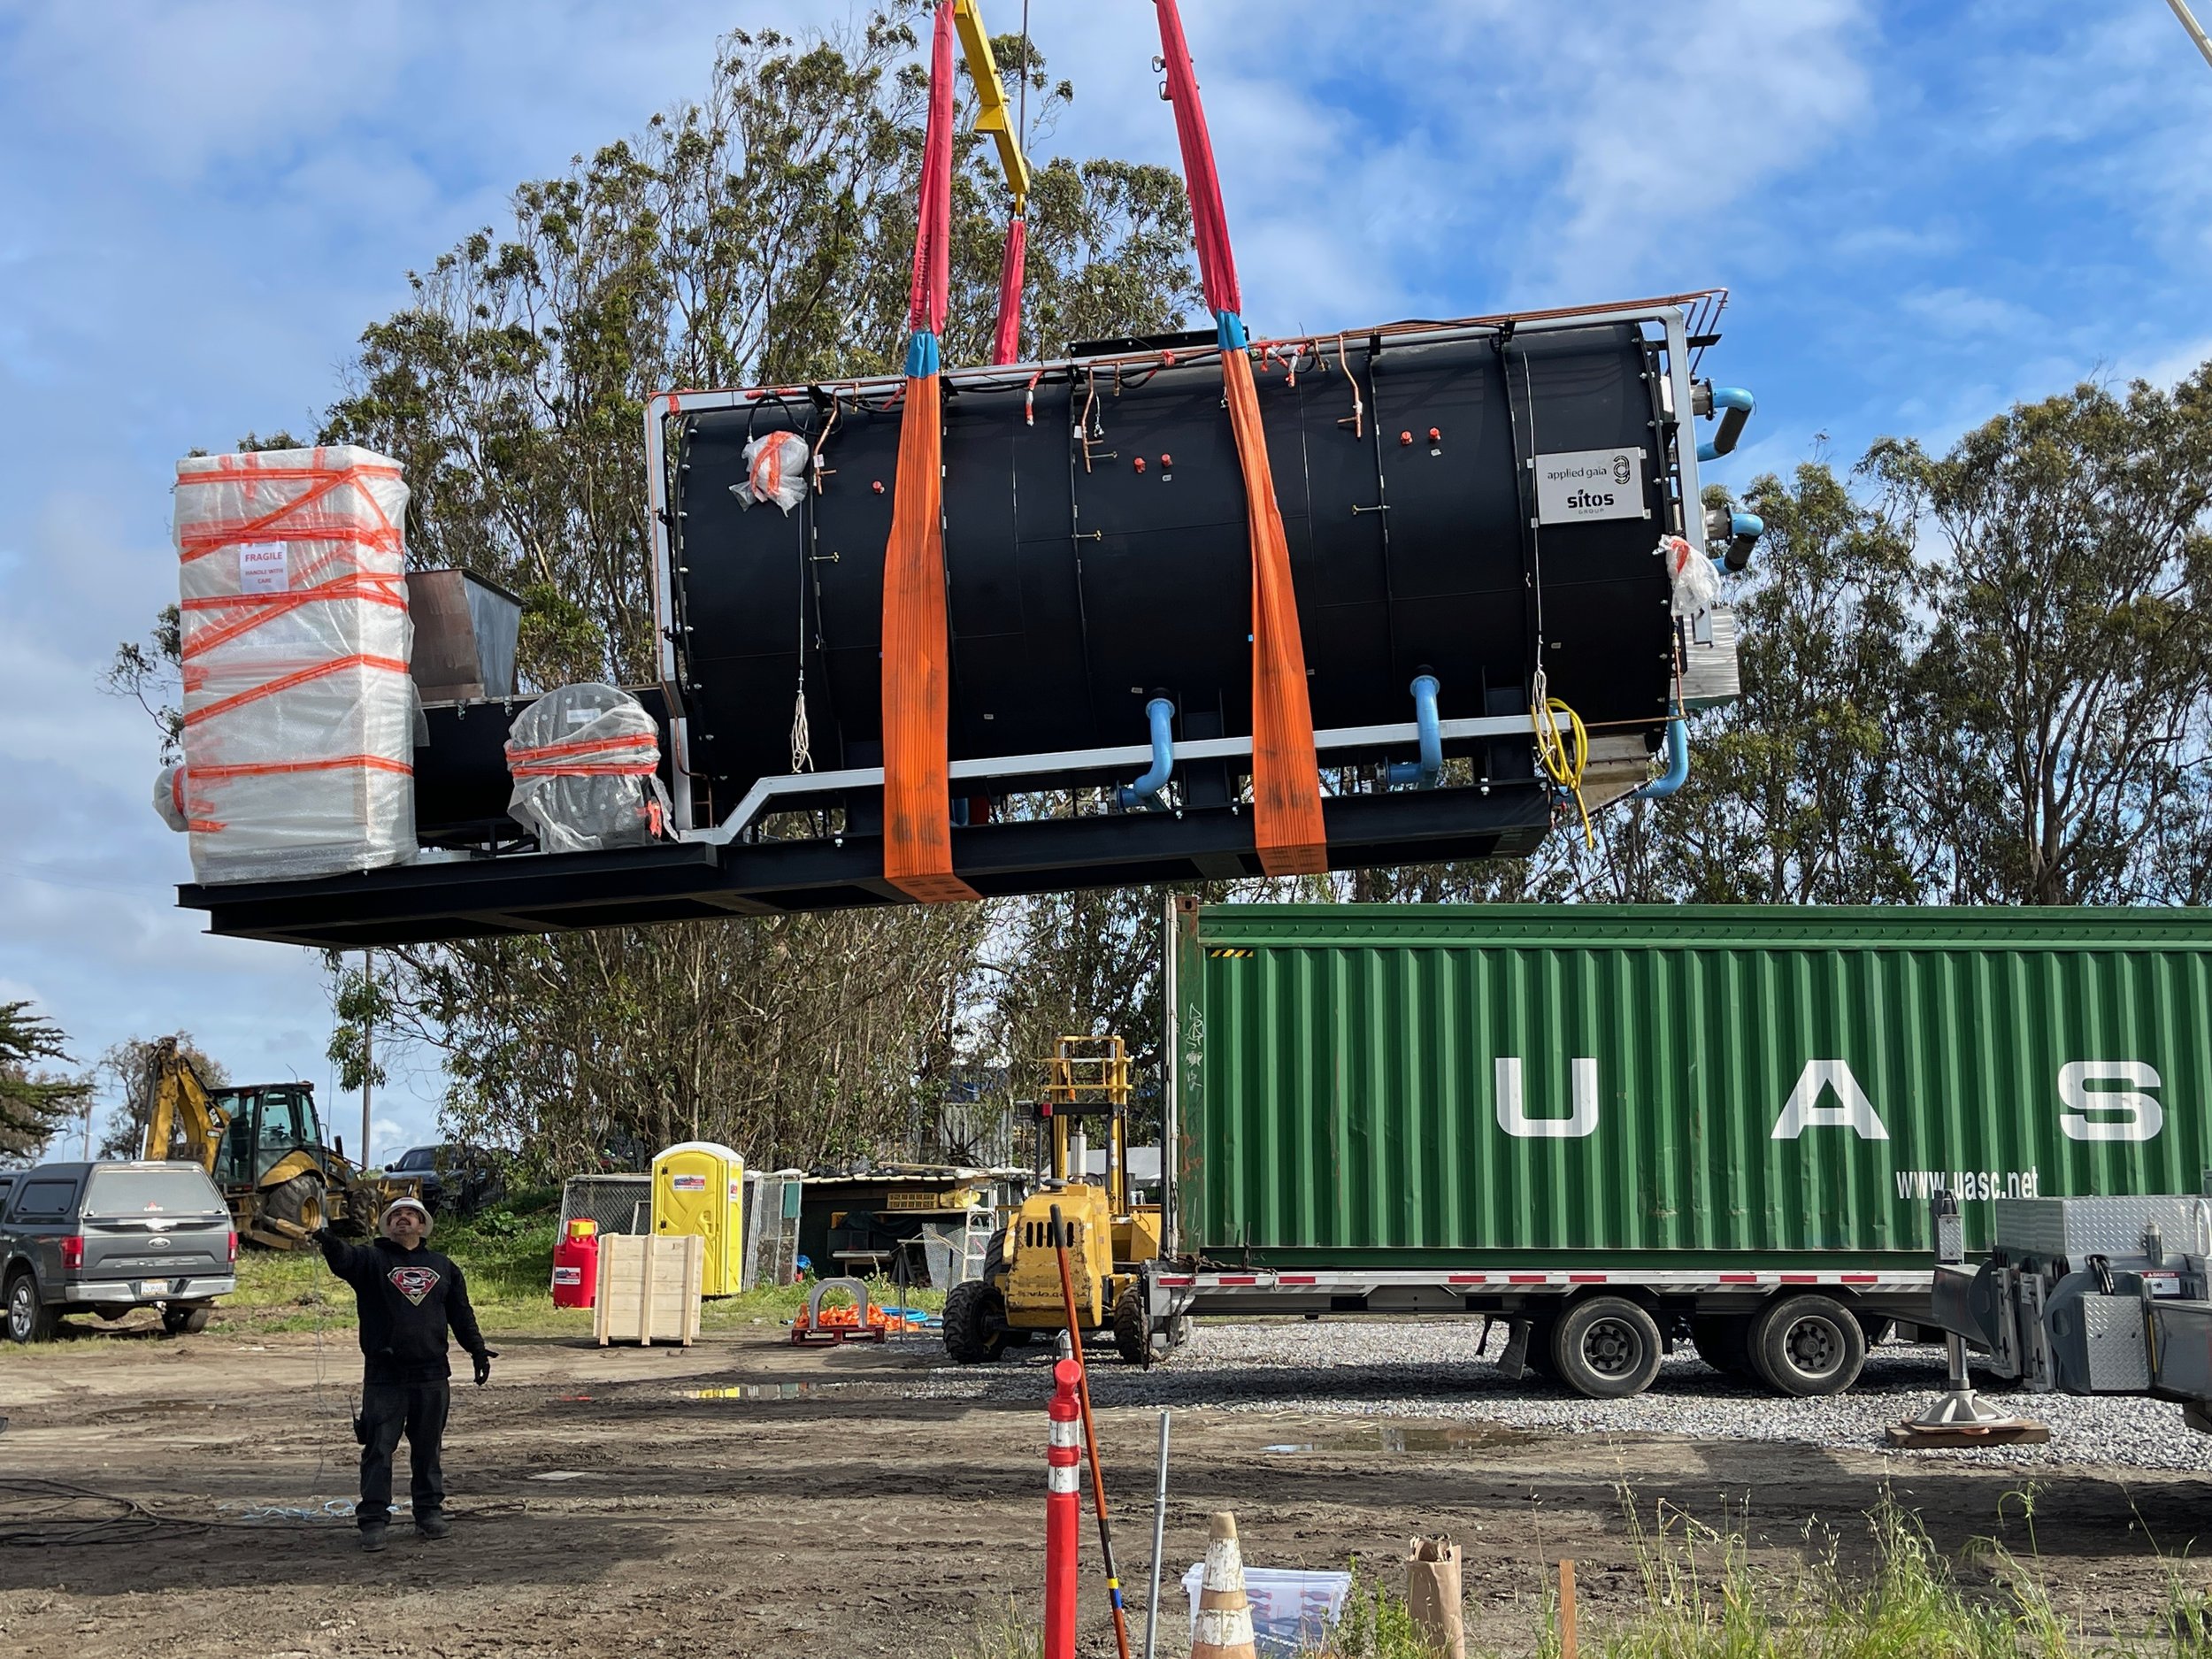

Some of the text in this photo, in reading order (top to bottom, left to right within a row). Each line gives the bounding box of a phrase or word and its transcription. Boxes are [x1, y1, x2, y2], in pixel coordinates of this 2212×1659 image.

[1548, 466, 1607, 481] applied gaia
[1567, 489, 1615, 509] sitos
[245, 551, 283, 562] FRAGILE
[1895, 1165, 2039, 1202] www.uasc.net
